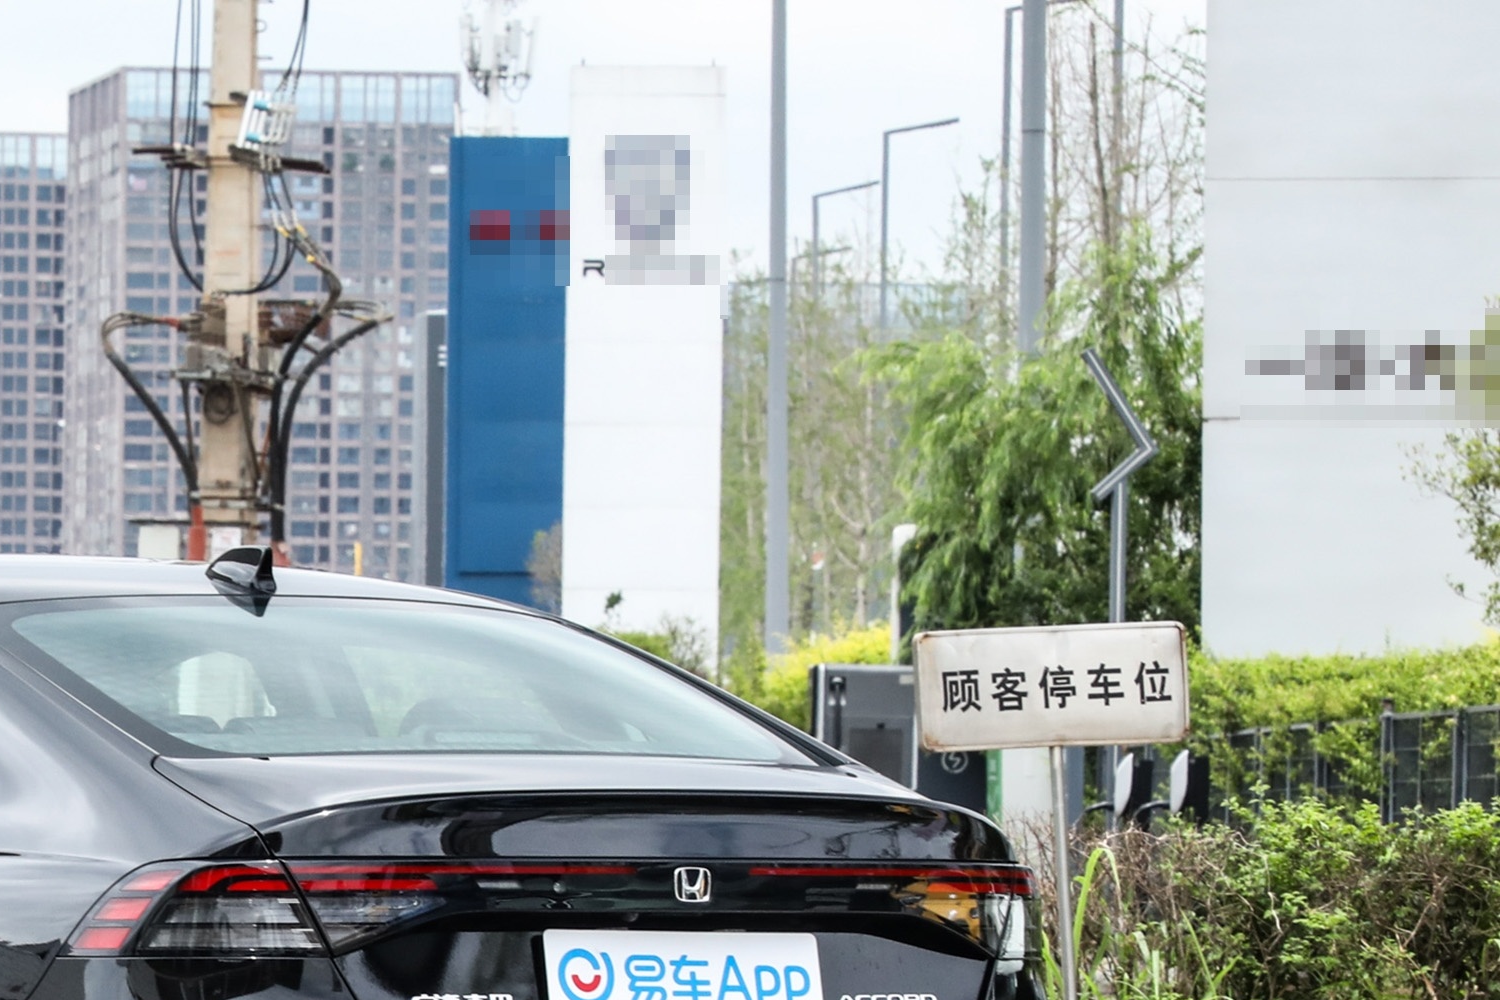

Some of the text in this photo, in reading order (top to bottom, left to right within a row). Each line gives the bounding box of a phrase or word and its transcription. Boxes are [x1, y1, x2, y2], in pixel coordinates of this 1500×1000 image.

[941, 660, 1173, 713] 顾客停车位
